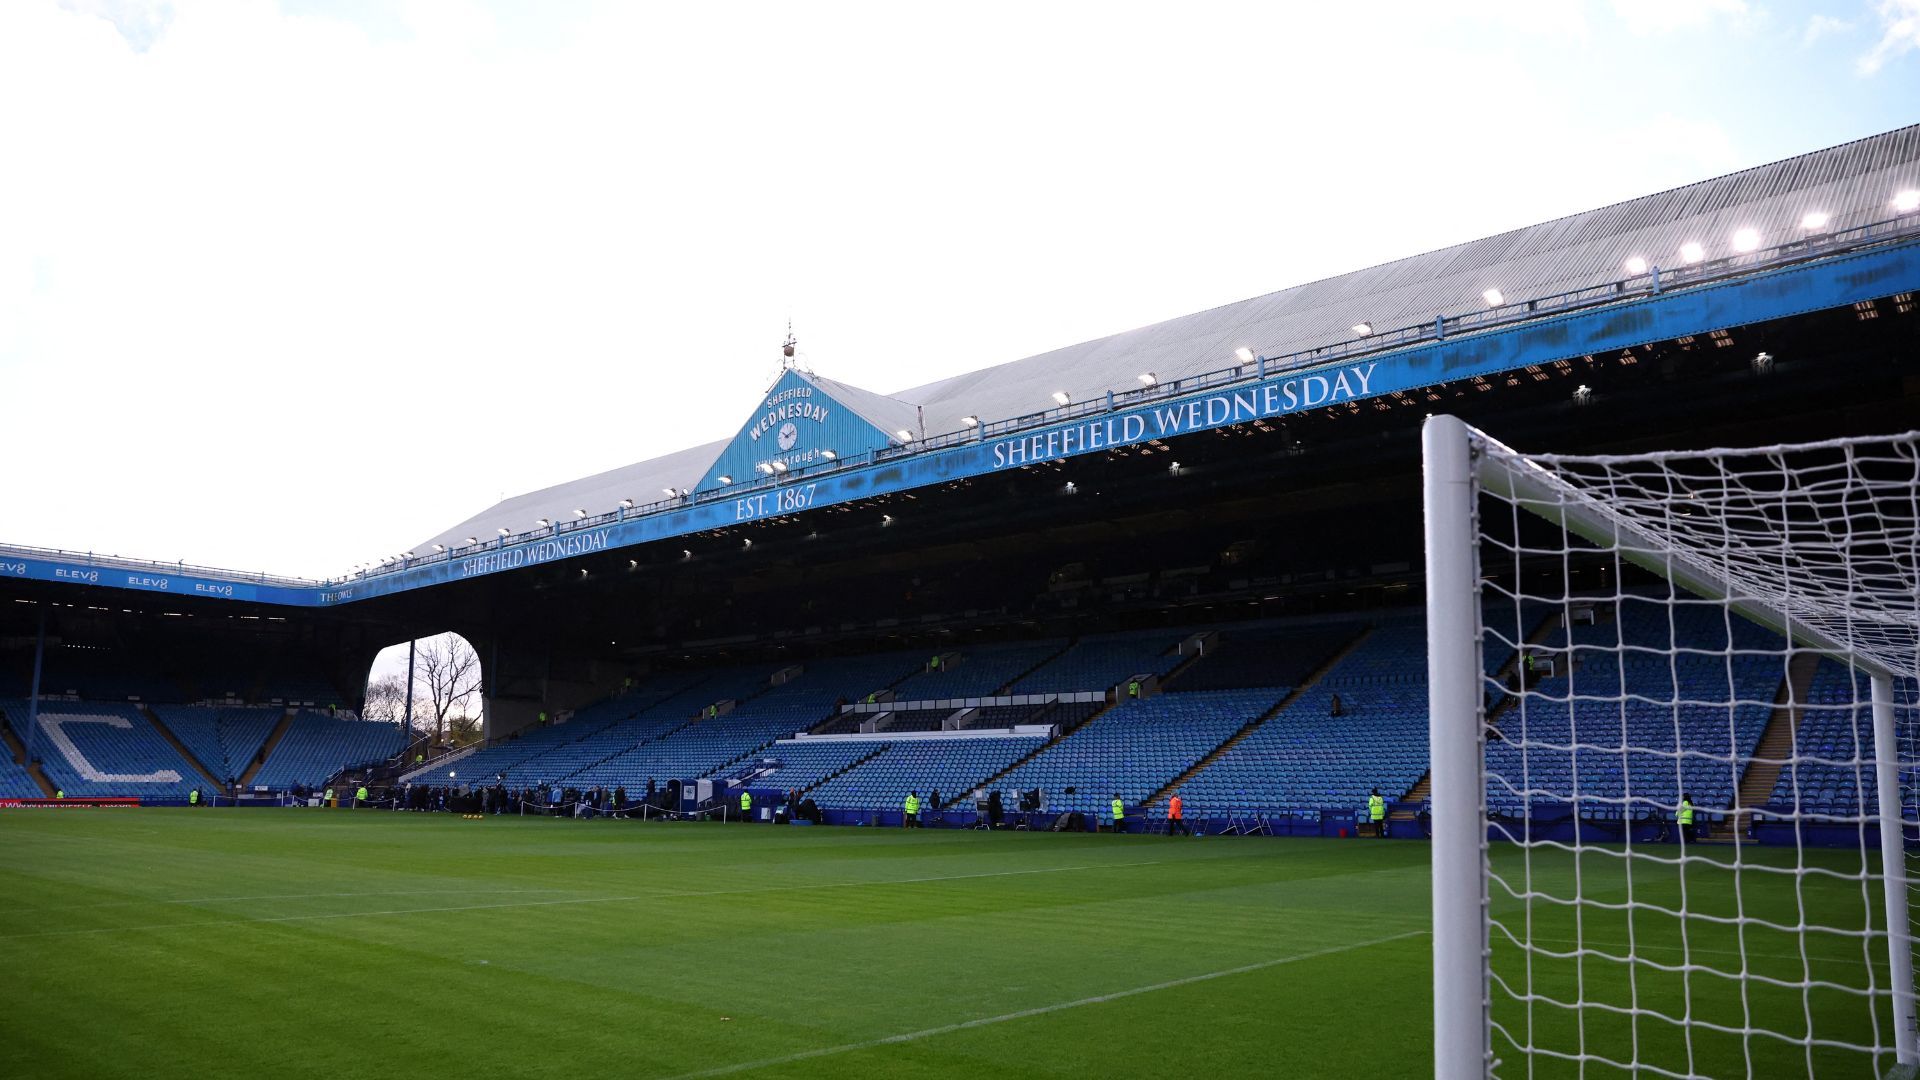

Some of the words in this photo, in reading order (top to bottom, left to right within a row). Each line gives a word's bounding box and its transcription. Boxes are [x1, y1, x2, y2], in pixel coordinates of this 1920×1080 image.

[767, 387, 812, 408] SHEFFIELD
[750, 402, 828, 441] WEDNESDAY
[993, 413, 1145, 469] SHEFFIELD
[1154, 363, 1377, 434] WEDNESDAY
[755, 448, 819, 472] Hiorough
[736, 494, 769, 520] EST.
[776, 483, 816, 512] 1867
[462, 549, 523, 577] SHEFFIELD
[527, 529, 610, 563] WEDNESDAY
[55, 568, 98, 582] ELEV8
[128, 576, 168, 589] ELEV8
[195, 583, 233, 596] ELEV8
[320, 593, 338, 601] THE
